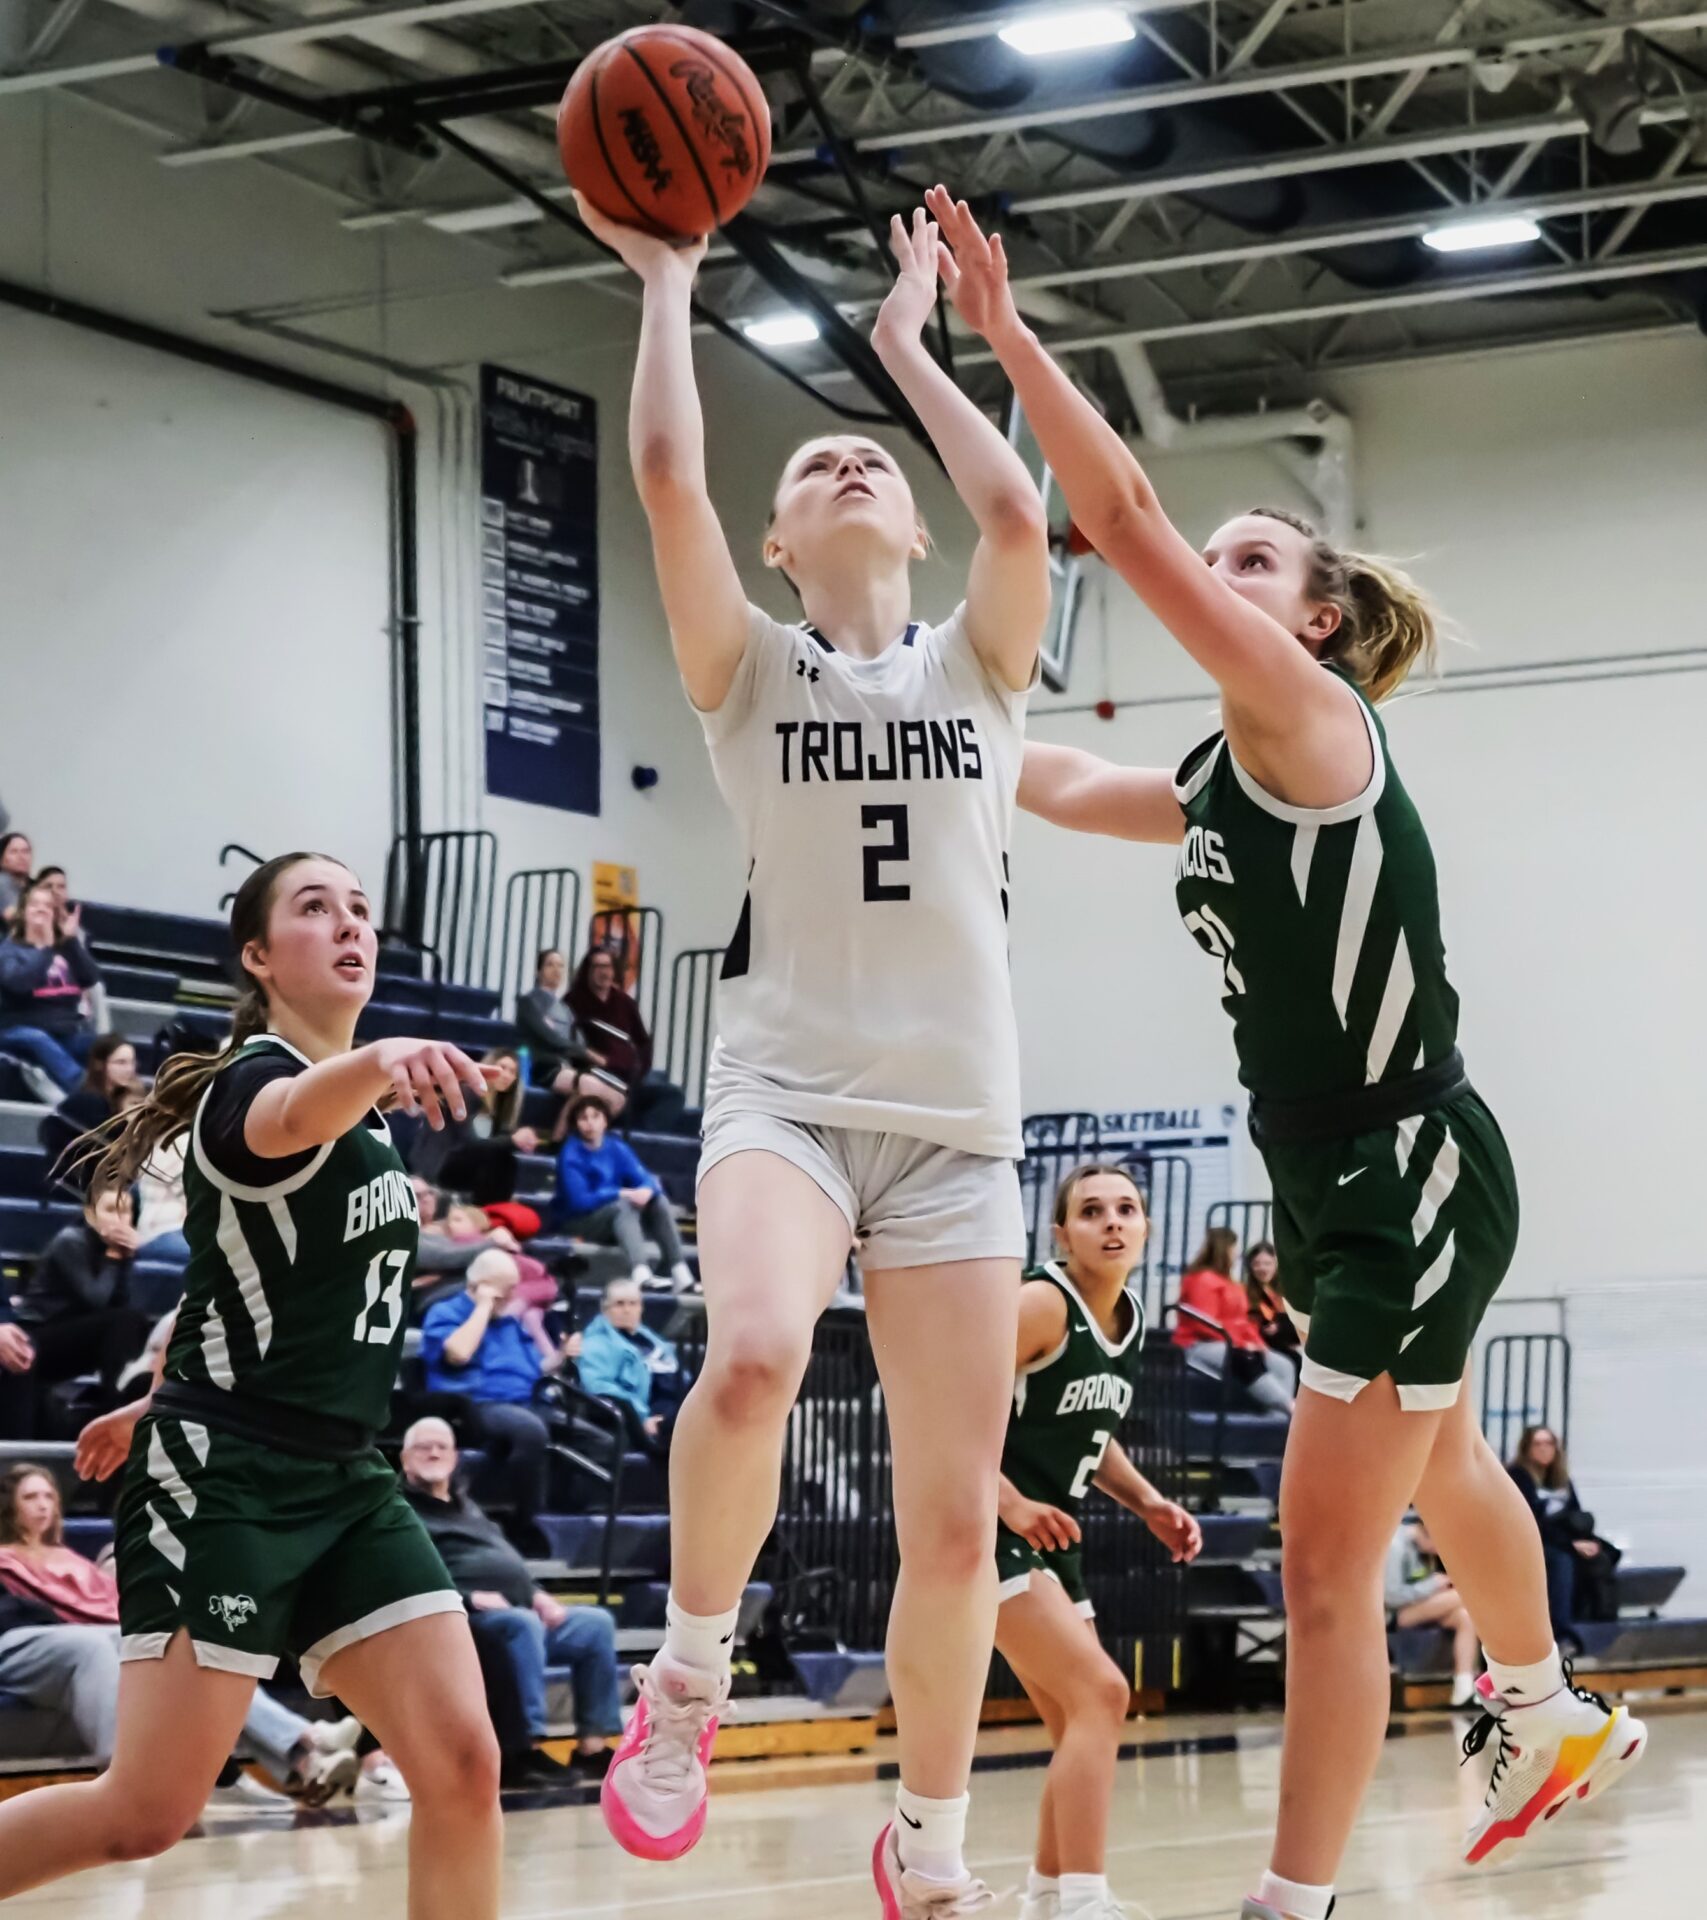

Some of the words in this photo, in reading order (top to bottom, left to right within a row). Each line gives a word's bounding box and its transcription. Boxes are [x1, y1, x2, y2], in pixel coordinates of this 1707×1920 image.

[775, 718, 982, 784] TROJANS
[861, 804, 911, 902] 2
[343, 1169, 421, 1243] BRONC
[353, 1249, 411, 1345] 13
